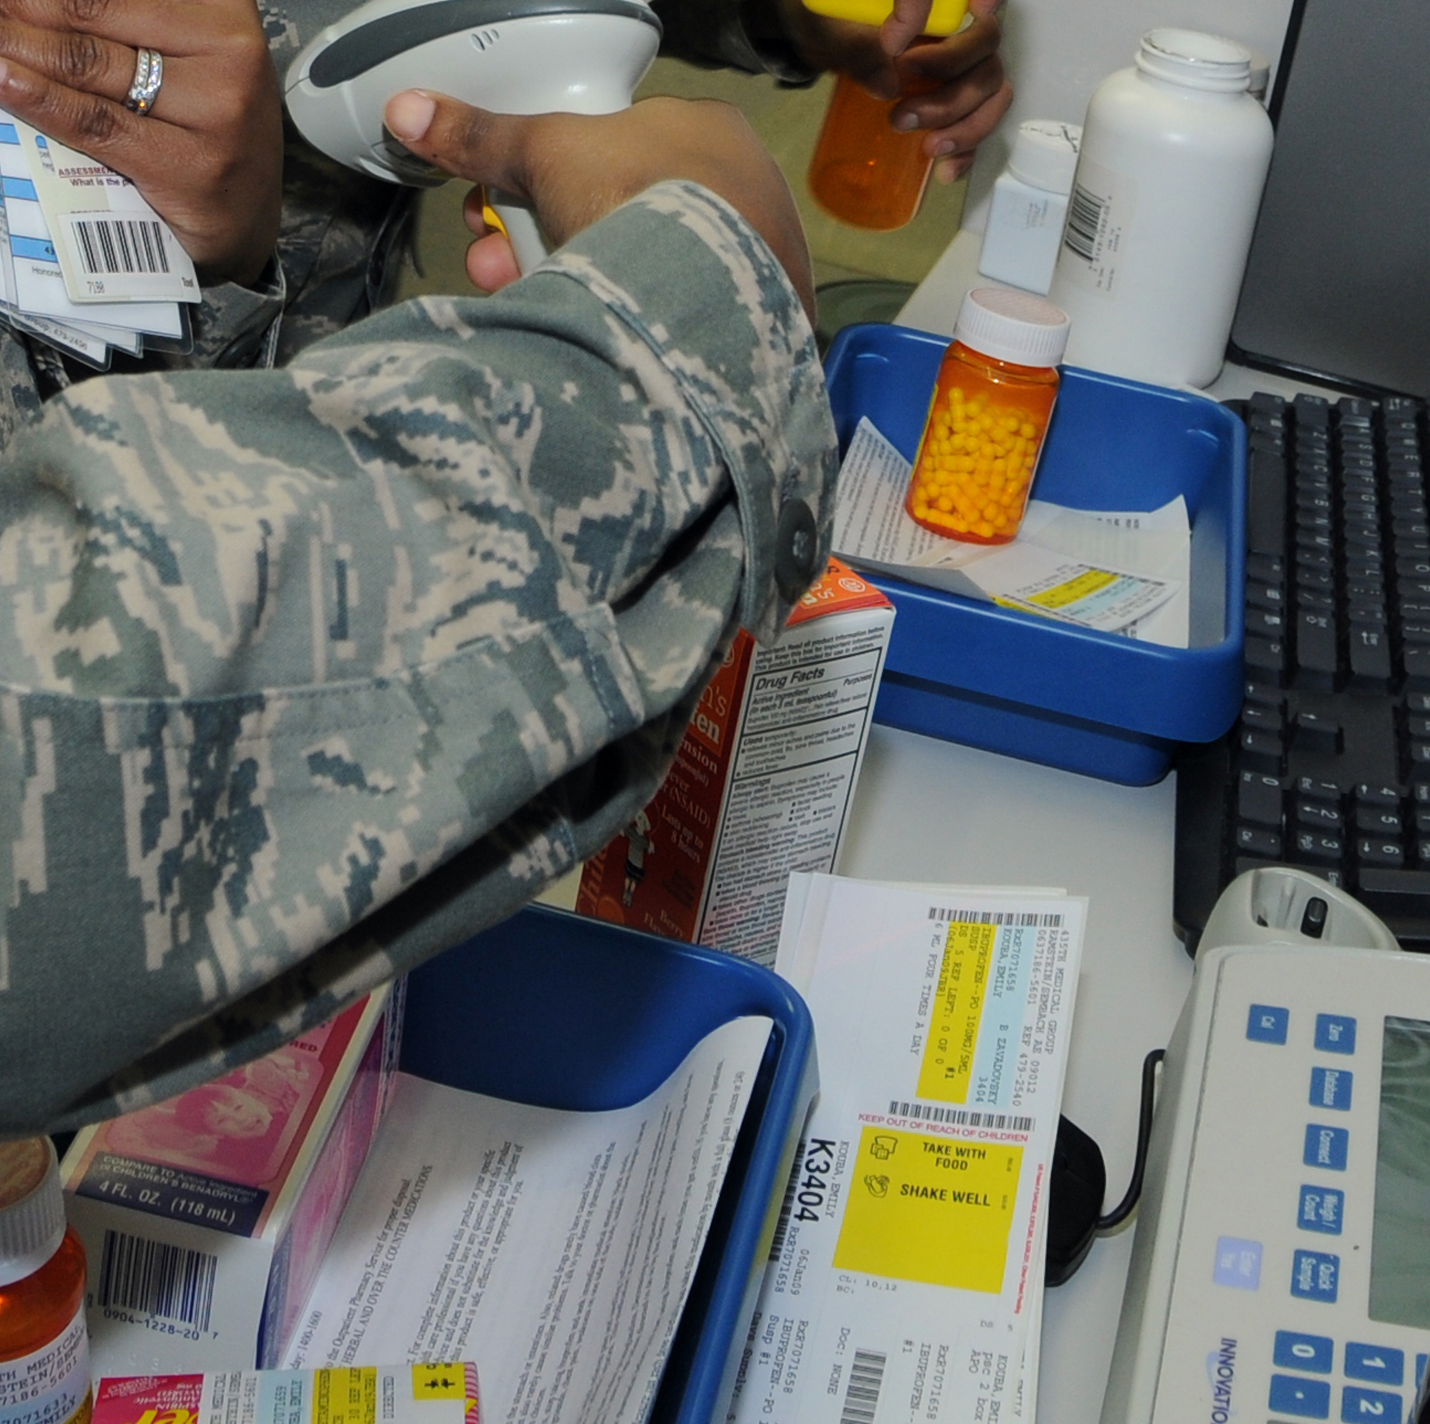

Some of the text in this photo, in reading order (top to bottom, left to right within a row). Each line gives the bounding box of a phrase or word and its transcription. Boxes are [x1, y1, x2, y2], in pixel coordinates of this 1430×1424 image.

[754, 665, 826, 694] Drug Facts
[1262, 777, 1278, 785] 0
[1379, 786, 1396, 795] 4
[1319, 809, 1337, 819] 2
[1379, 815, 1398, 824] 5
[1320, 839, 1339, 849] 3
[1381, 844, 1399, 854] 6
[929, 933, 941, 948] ML
[967, 925, 980, 952] SUSP
[924, 952, 938, 979] FOUR
[949, 961, 962, 982] REF
[917, 983, 932, 1016] TIMES
[942, 986, 957, 1019] LEFT:
[1043, 929, 1070, 1055] 435TH MEDICAL GROUP
[1011, 928, 1046, 1107] 0637186-5601 REF 479-2540
[1026, 928, 1058, 1094] RAMSTEIN/SEMBACH AE 09012
[1260, 1014, 1275, 1029] Cal
[909, 1034, 923, 1056] DAY
[936, 1038, 948, 1054] OF
[1327, 1023, 1342, 1042] Zero
[974, 1075, 988, 1103] 3404
[1321, 1069, 1338, 1106] Database
[857, 1112, 1029, 1144] KEEP OUT OF REACH OF CHILDREN
[922, 1141, 986, 1160] TAKE WITH
[1316, 1129, 1333, 1164] Connect
[103, 1155, 159, 1172] COMPARE
[162, 1165, 175, 1177] TO
[935, 1156, 968, 1171] FOOD
[792, 1135, 836, 1224] K3404
[99, 1180, 236, 1226] 4 FL. OZ. (118 mL)
[899, 1183, 991, 1206] SHAKE WELL
[1302, 1193, 1319, 1221] Count
[1318, 1193, 1338, 1220] Weigh
[458, 1199, 477, 1228] product
[384, 1218, 410, 1262] COUNTER
[452, 1225, 466, 1242] this
[443, 1240, 460, 1263] about
[326, 1175, 412, 1361] the Outpatient Pharmacy Service for proper disposal.
[376, 1259, 393, 1280] THE
[789, 1247, 810, 1297] 06Jan09
[1294, 1256, 1316, 1292] Sample
[1316, 1262, 1334, 1290] Quick
[366, 1277, 386, 1306] OVER
[427, 1260, 453, 1306] information
[103, 1308, 200, 1342] 0904-1228-20
[357, 1303, 375, 1327] AND
[414, 1304, 437, 1341] complete
[761, 1313, 779, 1345] Susp
[341, 1325, 366, 1365] HERBAL
[454, 1315, 475, 1347] product
[26, 1325, 81, 1375] MEDICAL
[407, 1339, 422, 1356] For
[967, 1349, 980, 1374] APO
[1292, 1344, 1315, 1358] 0
[1362, 1356, 1386, 1369] 1
[826, 1363, 842, 1395] NONE
[1211, 1337, 1237, 1424] INNOVATIO
[1360, 1399, 1384, 1416] 2
